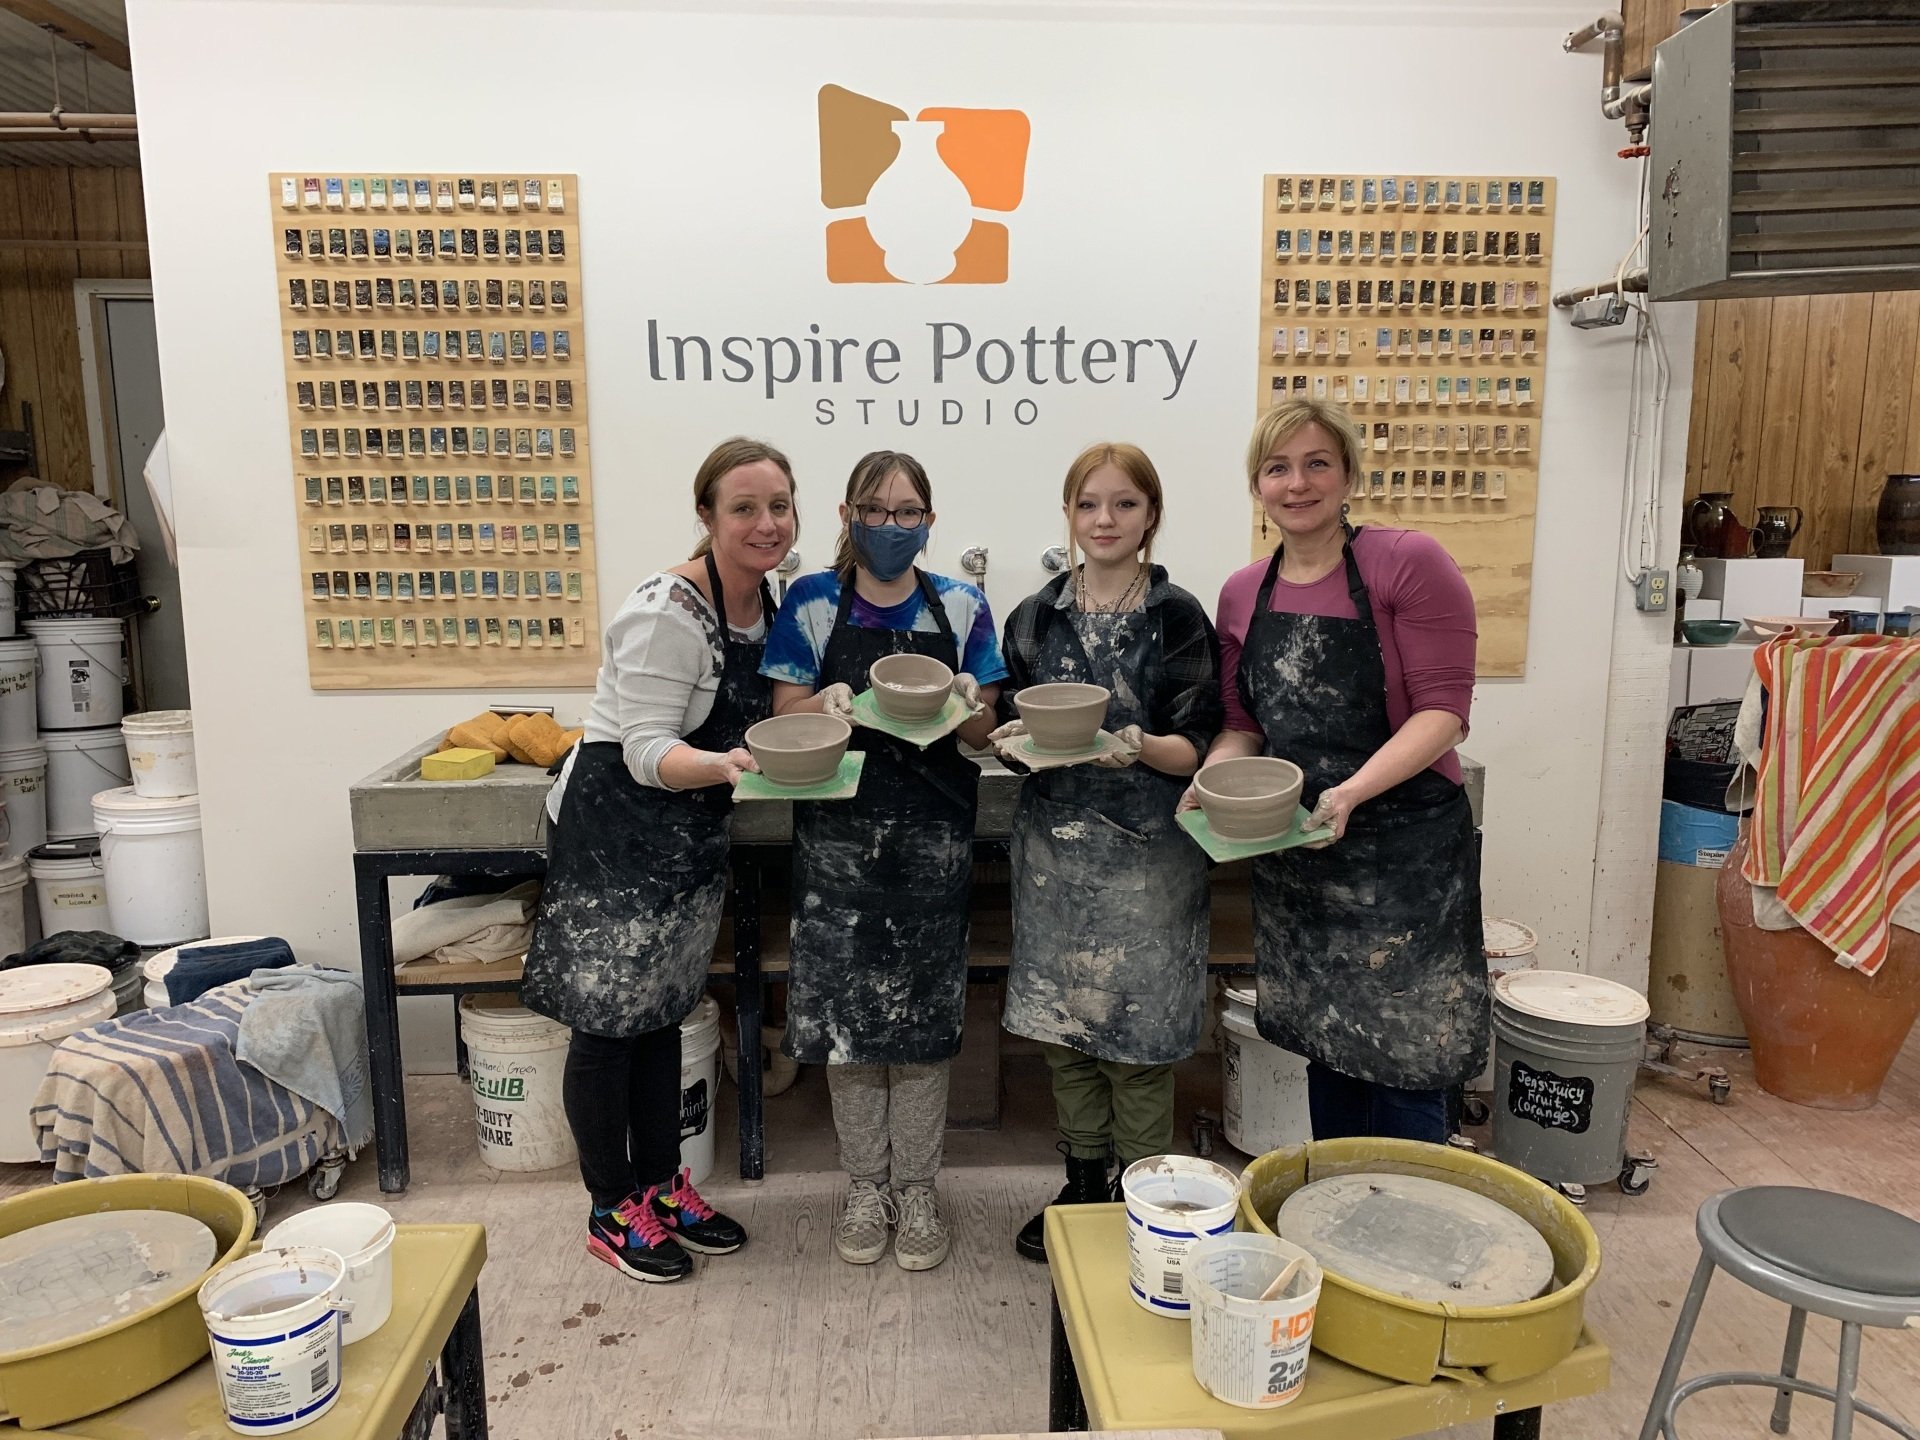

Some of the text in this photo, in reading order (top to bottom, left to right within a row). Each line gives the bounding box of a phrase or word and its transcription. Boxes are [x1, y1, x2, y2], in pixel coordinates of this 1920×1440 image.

[647, 319, 1197, 400] Inspire Pottery
[815, 398, 1038, 426] STUDIO
[508, 1062, 537, 1075] Green
[1548, 1081, 1584, 1105] Juicy
[313, 1348, 327, 1360] USA
[1268, 1362, 1288, 1384] 2
